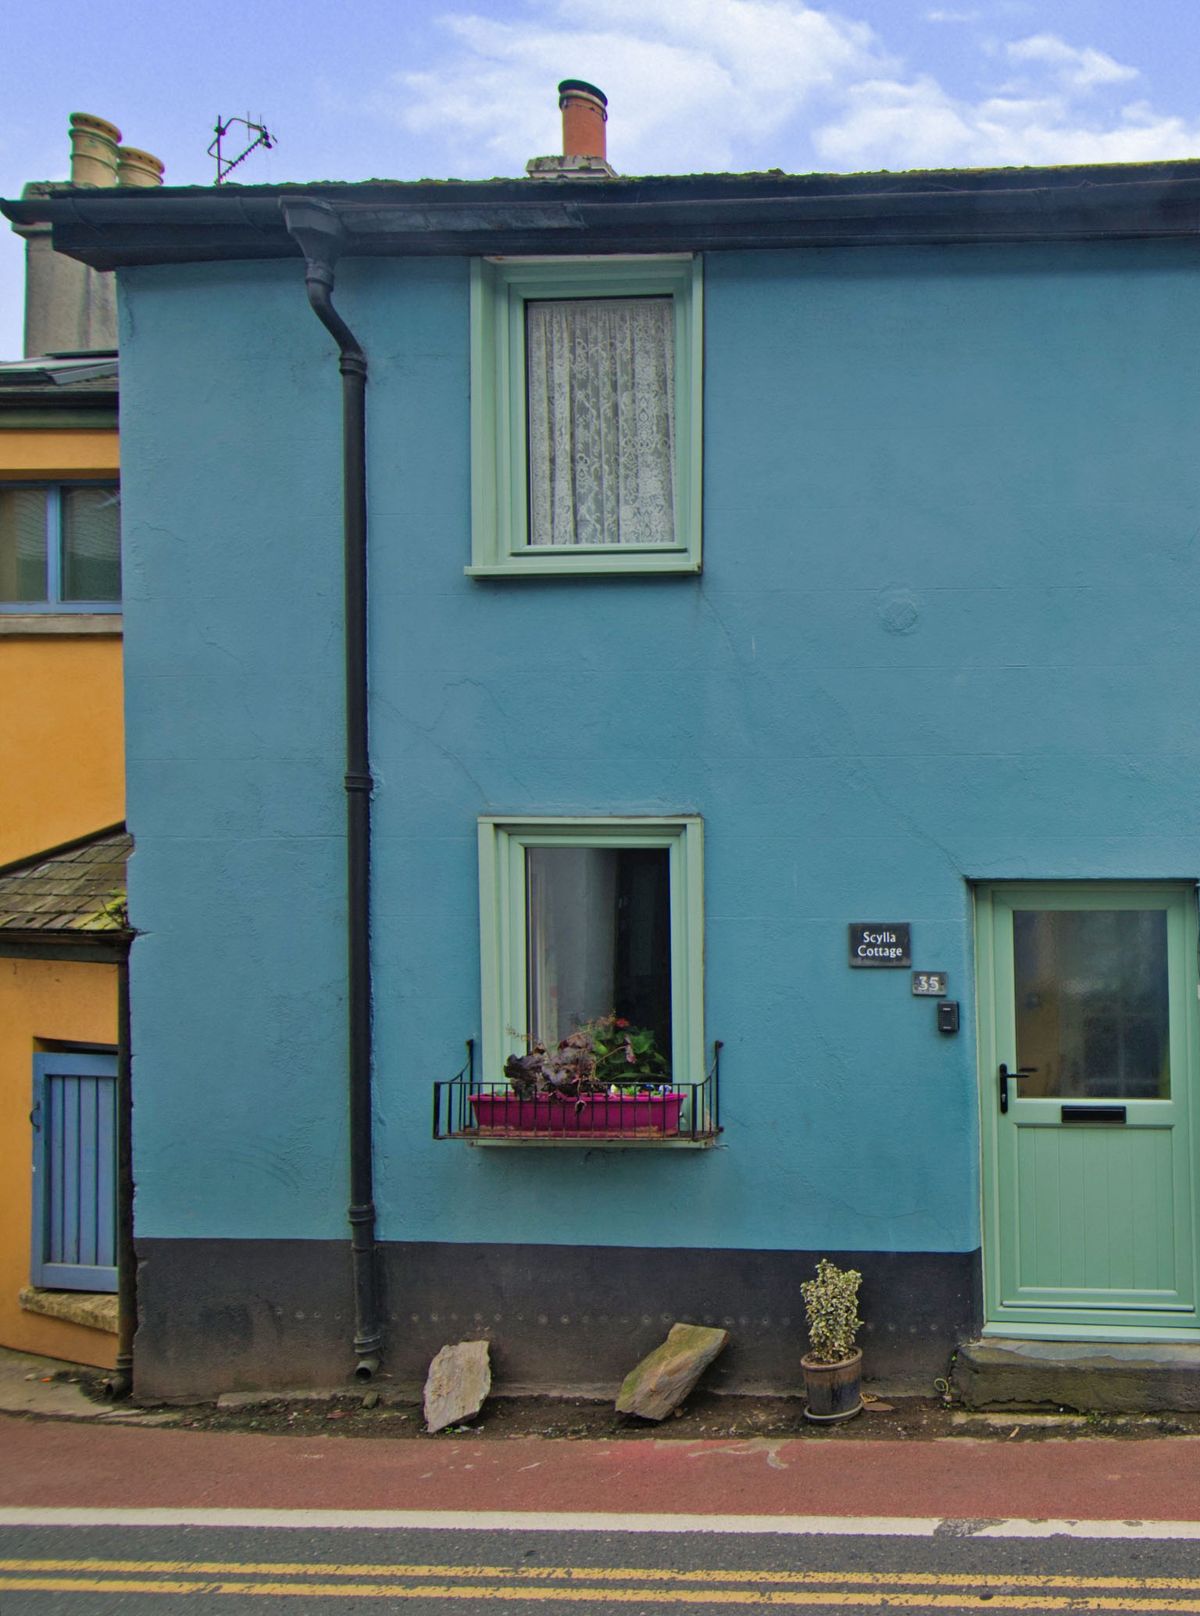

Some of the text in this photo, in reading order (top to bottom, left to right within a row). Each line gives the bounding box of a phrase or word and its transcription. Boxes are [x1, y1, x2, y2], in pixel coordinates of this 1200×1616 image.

[863, 931, 896, 944] Scylla
[857, 945, 903, 958] Cottage
[918, 976, 939, 991] 35
